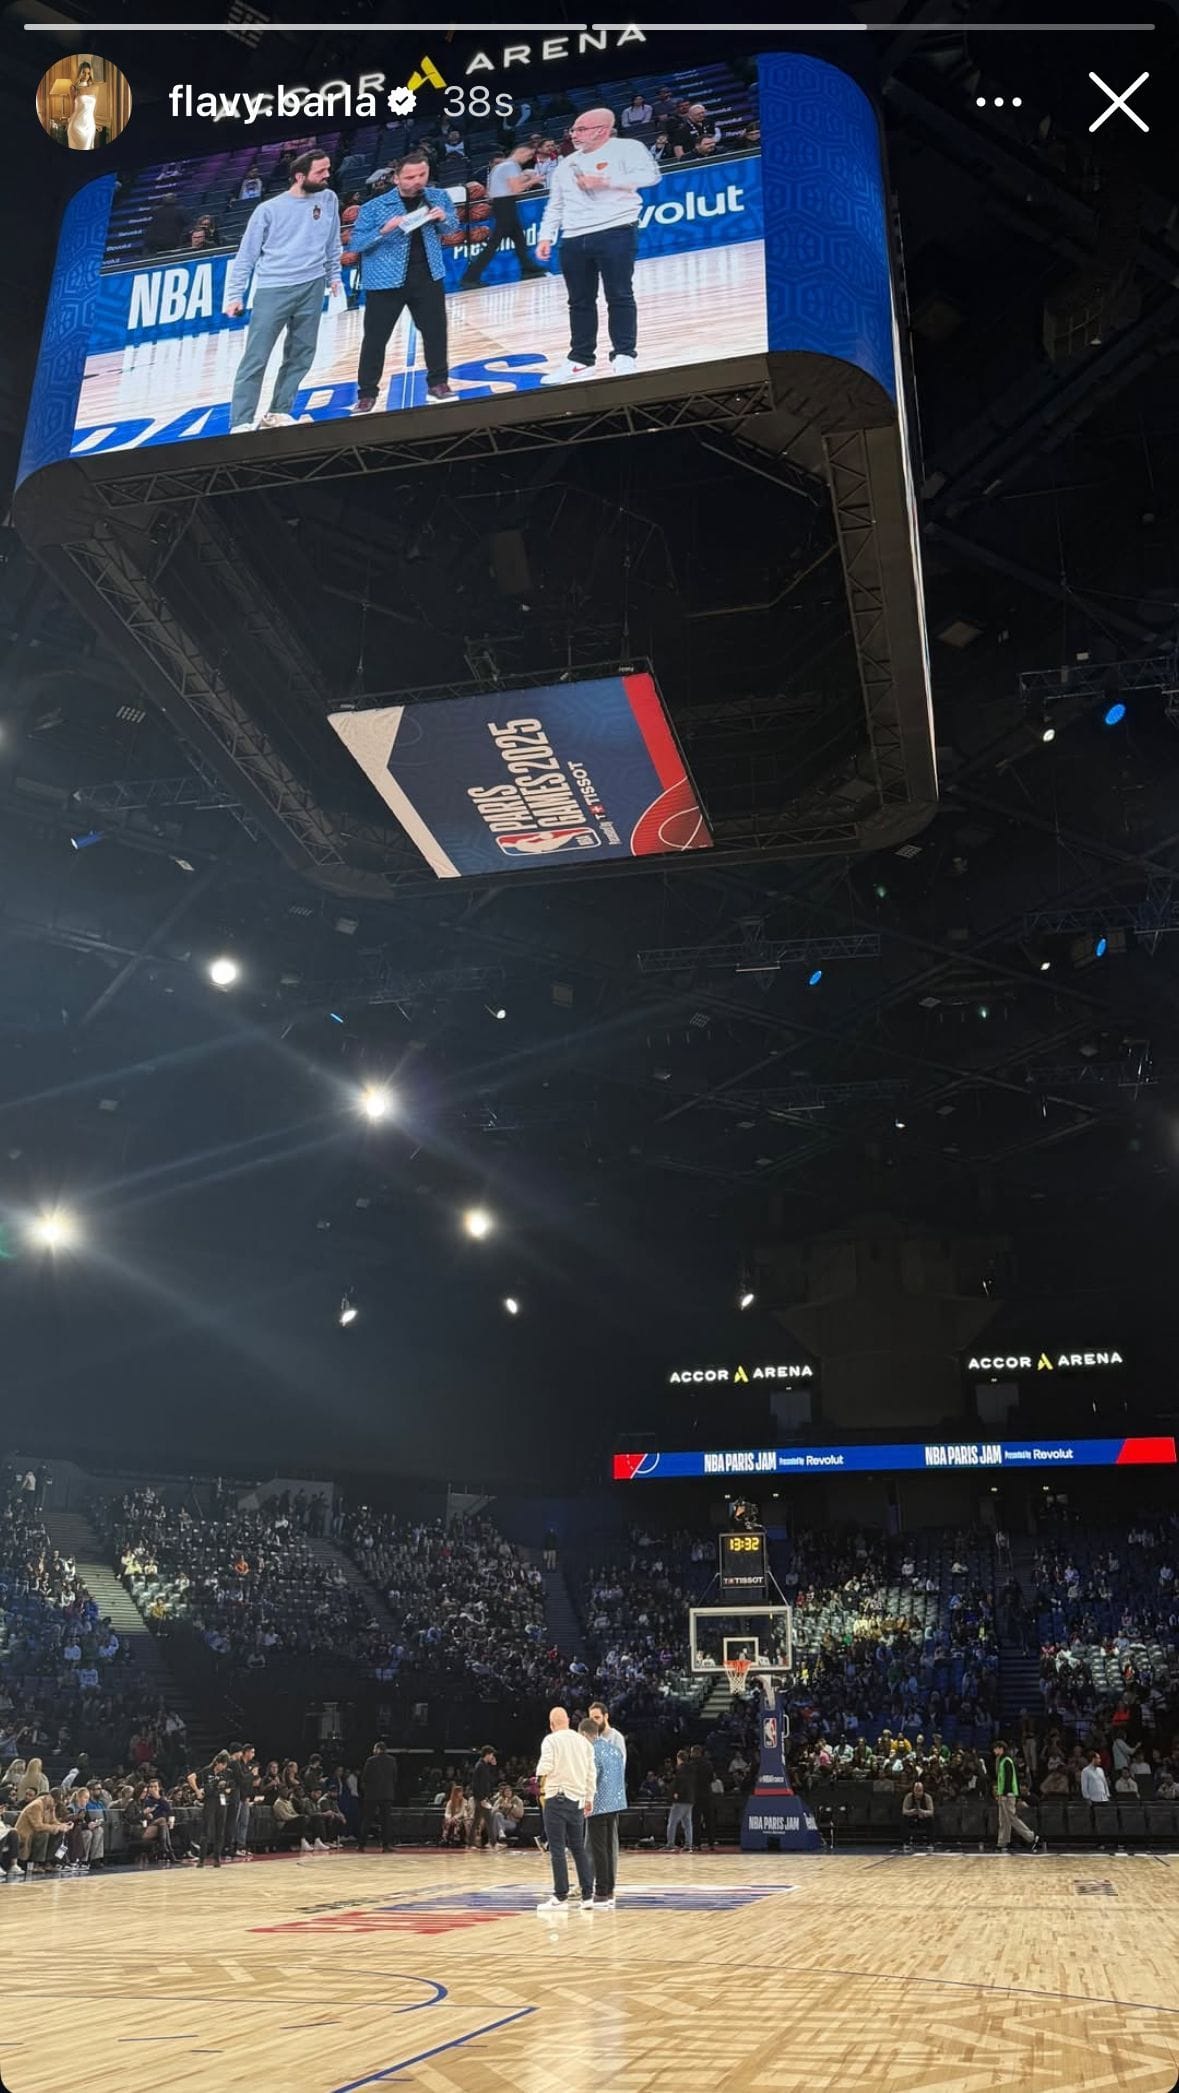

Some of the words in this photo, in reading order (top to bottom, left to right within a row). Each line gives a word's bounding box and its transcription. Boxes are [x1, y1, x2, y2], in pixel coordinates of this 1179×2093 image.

[465, 23, 647, 75] ARENA
[638, 185, 745, 229] volut
[127, 262, 213, 330] NBA
[487, 718, 560, 774] 2025
[514, 772, 587, 828] GAMES
[567, 761, 600, 806] TISSOT
[467, 784, 538, 832] PARIS
[669, 1369, 729, 1383] ACCOR
[752, 1364, 814, 1379] ARENA
[968, 1356, 1032, 1370] ACCOR
[1057, 1351, 1124, 1367] ARENA
[704, 1453, 725, 1473] NBA
[725, 1452, 755, 1472] PARIS
[755, 1451, 777, 1471] JAM
[806, 1455, 844, 1466] Revolut
[924, 1446, 947, 1466] NBA
[947, 1445, 978, 1465] PARIS
[979, 1444, 1002, 1465] JAM
[1033, 1448, 1074, 1460] Revolut
[730, 1537, 760, 1551] 13:32
[735, 1576, 764, 1585] TISSOT
[749, 1816, 763, 1830] NBA
[763, 1816, 784, 1830] PARIS
[784, 1816, 800, 1831] JAM
